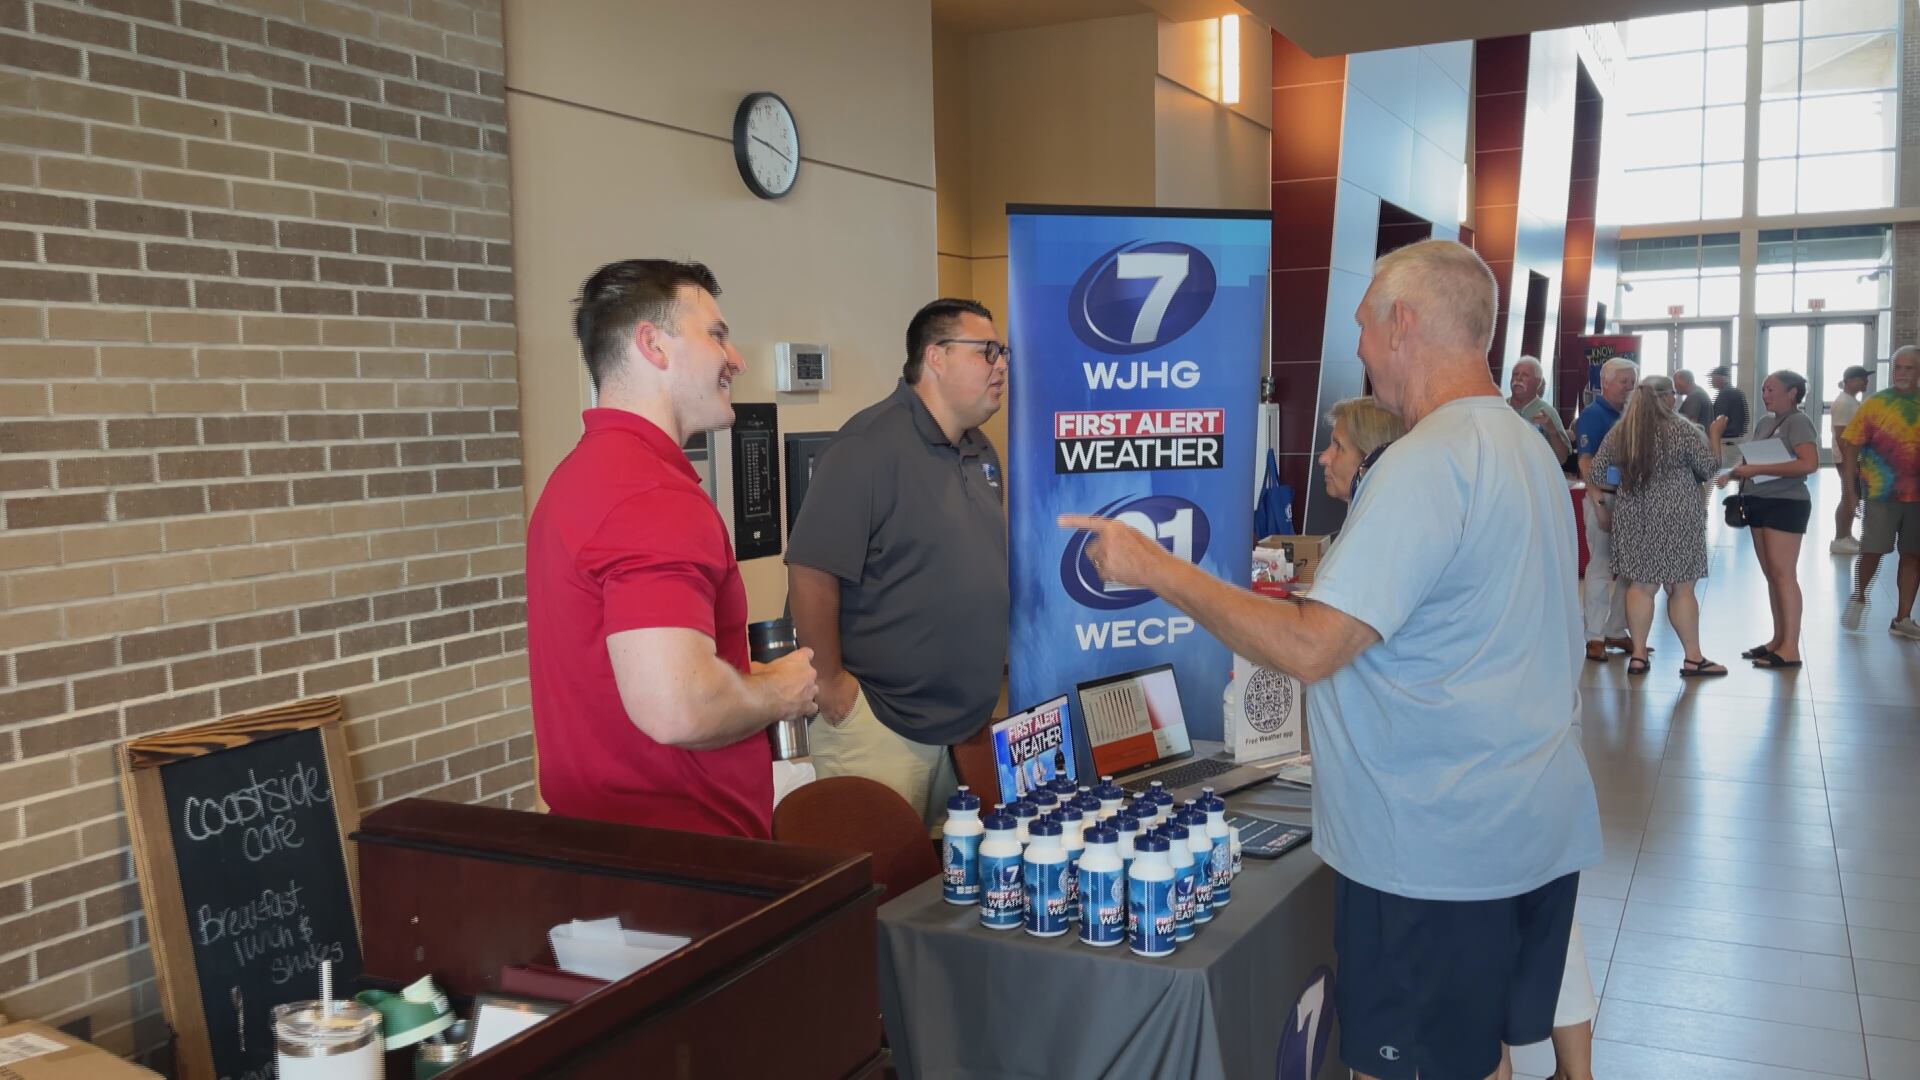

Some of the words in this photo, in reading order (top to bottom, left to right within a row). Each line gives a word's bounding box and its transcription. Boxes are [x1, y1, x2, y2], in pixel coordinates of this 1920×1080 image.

[1117, 252, 1190, 344] 7
[1083, 360, 1201, 390] WJHG
[1058, 413, 1132, 437] FIRST
[1136, 411, 1220, 435] ALERT
[1060, 437, 1218, 471] WEATHER
[1075, 616, 1195, 651] WECP
[1009, 723, 1032, 742] FIRST
[1034, 708, 1060, 732] ALERT
[1245, 737, 1258, 746] Free
[1283, 730, 1294, 739] app
[1010, 725, 1063, 765] WEATHER
[184, 761, 331, 841] Coastside
[1006, 865, 1020, 884] 7
[1183, 874, 1195, 895] 7
[1297, 975, 1325, 1080] 7
